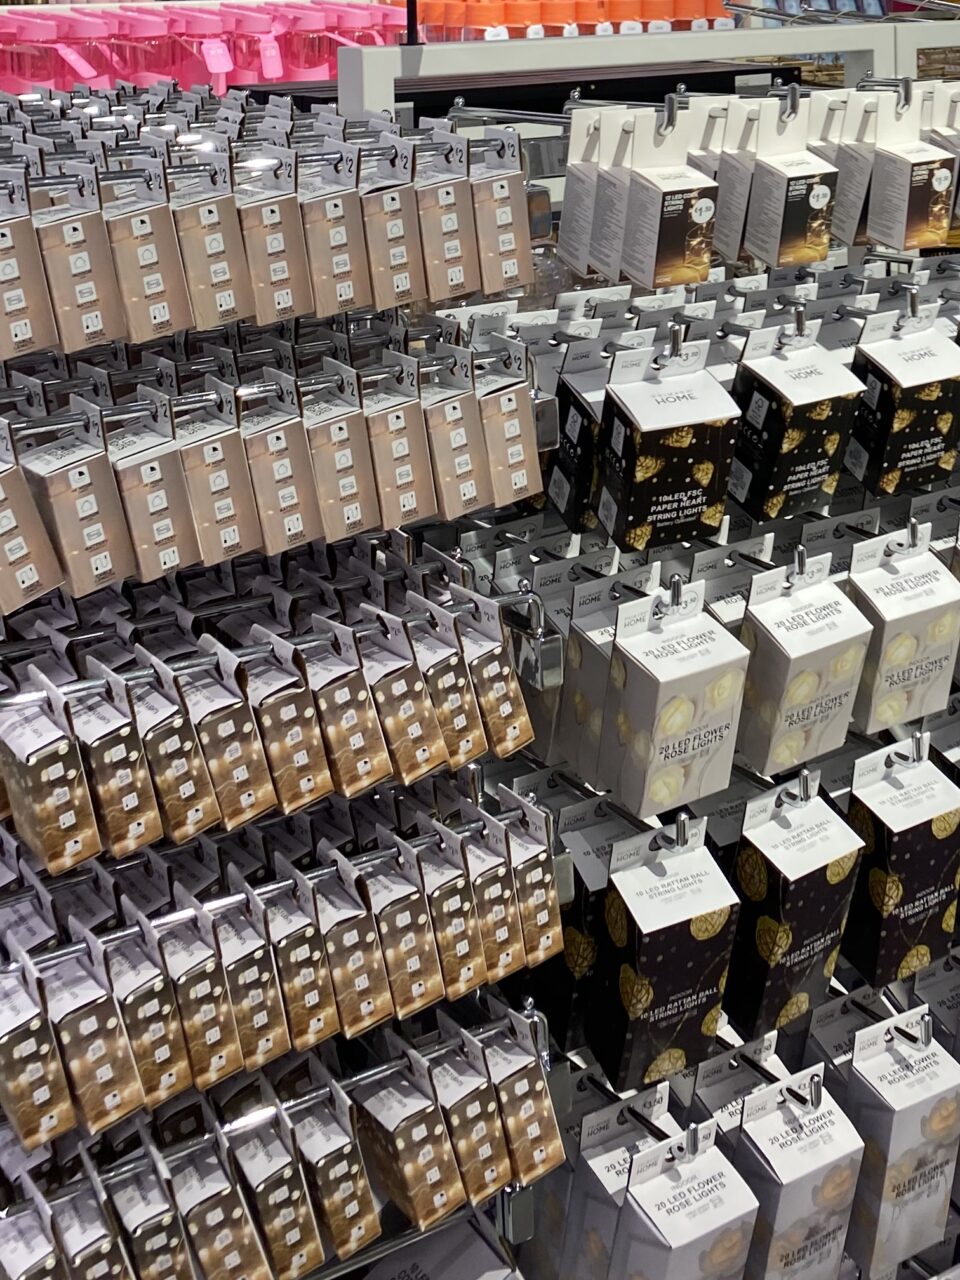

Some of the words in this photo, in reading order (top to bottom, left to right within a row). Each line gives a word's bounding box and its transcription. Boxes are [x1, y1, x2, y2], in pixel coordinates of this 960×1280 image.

[902, 349, 937, 364] HOME
[790, 367, 825, 382] HOME
[655, 393, 697, 405] HOME
[782, 480, 807, 491] STRING
[680, 496, 708, 507] HEART
[647, 511, 677, 522] STRING
[679, 505, 708, 517] LIGHTS
[500, 558, 522, 570] HOME
[697, 562, 718, 574] HOME
[539, 576, 562, 588] HOME
[578, 595, 601, 608] HOME
[623, 615, 646, 629] HOME
[784, 619, 810, 633] ROSE
[812, 608, 842, 625] LIGHTS
[786, 614, 804, 626] LED
[805, 600, 842, 620] FLOWER
[654, 647, 681, 661] ROSE
[682, 637, 717, 652] LIGHTS
[655, 642, 676, 654] LED
[677, 629, 717, 648] FLOWER
[888, 675, 912, 688] ROSE
[914, 664, 944, 681] LIGHTS
[896, 666, 914, 680] LED
[914, 655, 950, 675] FLOWER
[658, 744, 670, 756] 20
[672, 737, 691, 751] LED
[693, 722, 731, 744] FLOWER
[663, 747, 689, 761] ROSE
[692, 734, 724, 752] LIGHTS
[616, 849, 641, 864] HOME
[645, 884, 661, 896] LED
[661, 876, 690, 891] RATTAN
[649, 887, 676, 900] STRING
[677, 878, 703, 892] LIGHTS
[650, 1005, 666, 1017] LED
[667, 994, 698, 1011] RATTAN
[699, 986, 719, 1000] BALL
[650, 1008, 678, 1023] STRING
[679, 997, 707, 1012] LIGHTS
[887, 1071, 911, 1087] ROSE
[912, 1060, 940, 1077] LIGHTS
[889, 1065, 906, 1079] LED
[906, 1051, 939, 1071] FLOWER
[587, 1123, 611, 1139] HOME
[769, 1134, 780, 1146] 20
[781, 1126, 798, 1141] LED
[798, 1109, 835, 1133] FLOWER
[779, 1133, 804, 1151] ROSE
[805, 1119, 836, 1139] LIGHTS
[636, 1160, 659, 1176] HOME
[654, 1200, 668, 1213] 20
[669, 1191, 686, 1207] LED
[687, 1171, 727, 1198] FLOWER
[670, 1173, 700, 1192] INDOOR
[666, 1198, 691, 1217] ROSE
[692, 1181, 727, 1204] LIGHTS
